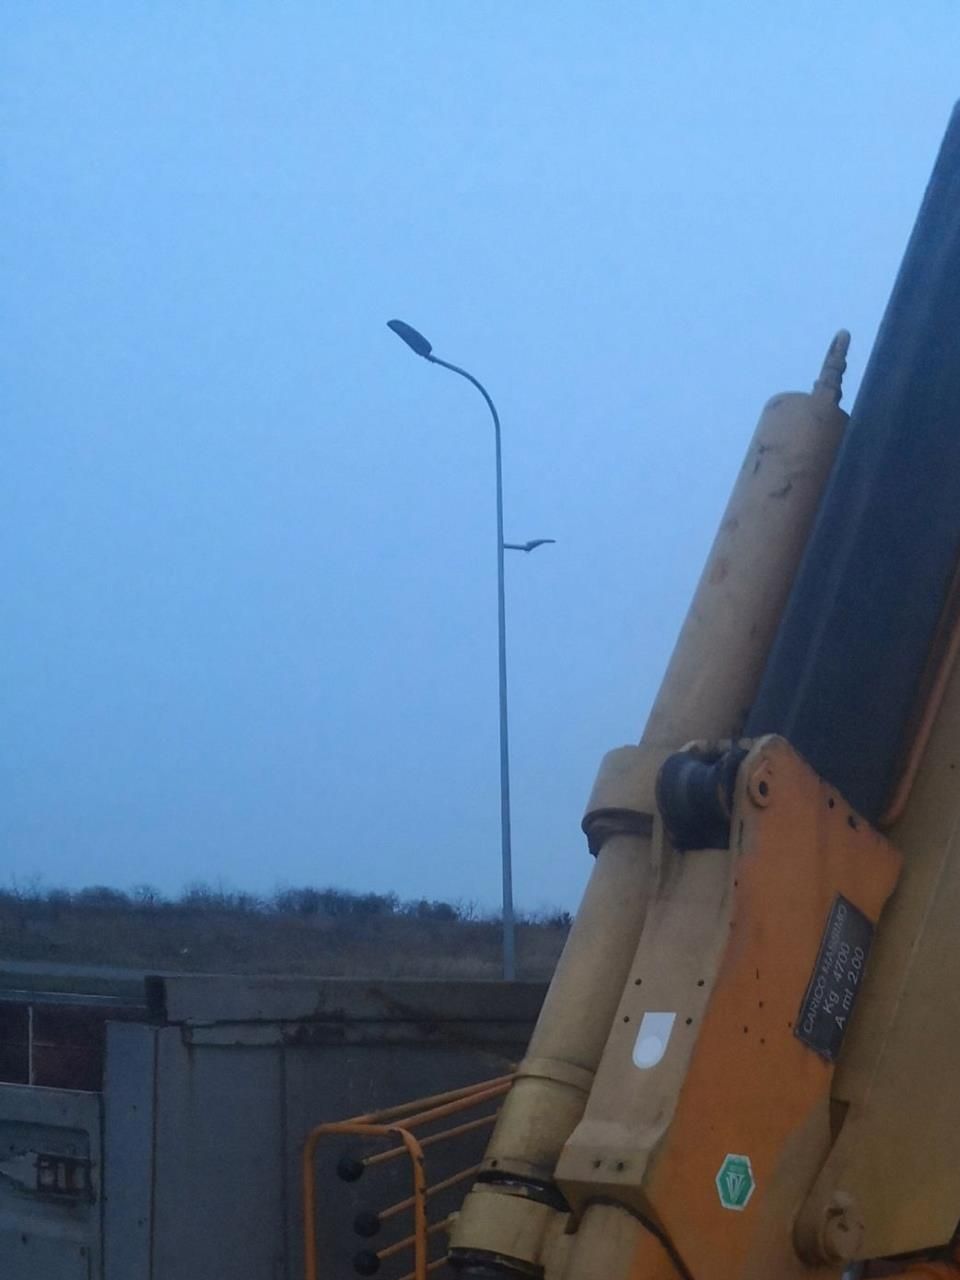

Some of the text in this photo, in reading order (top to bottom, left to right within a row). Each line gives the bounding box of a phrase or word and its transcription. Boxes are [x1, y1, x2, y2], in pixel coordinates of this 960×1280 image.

[803, 976, 826, 1033] CARICO
[822, 943, 850, 1014] Kg 4700
[835, 1015, 846, 1030] A
